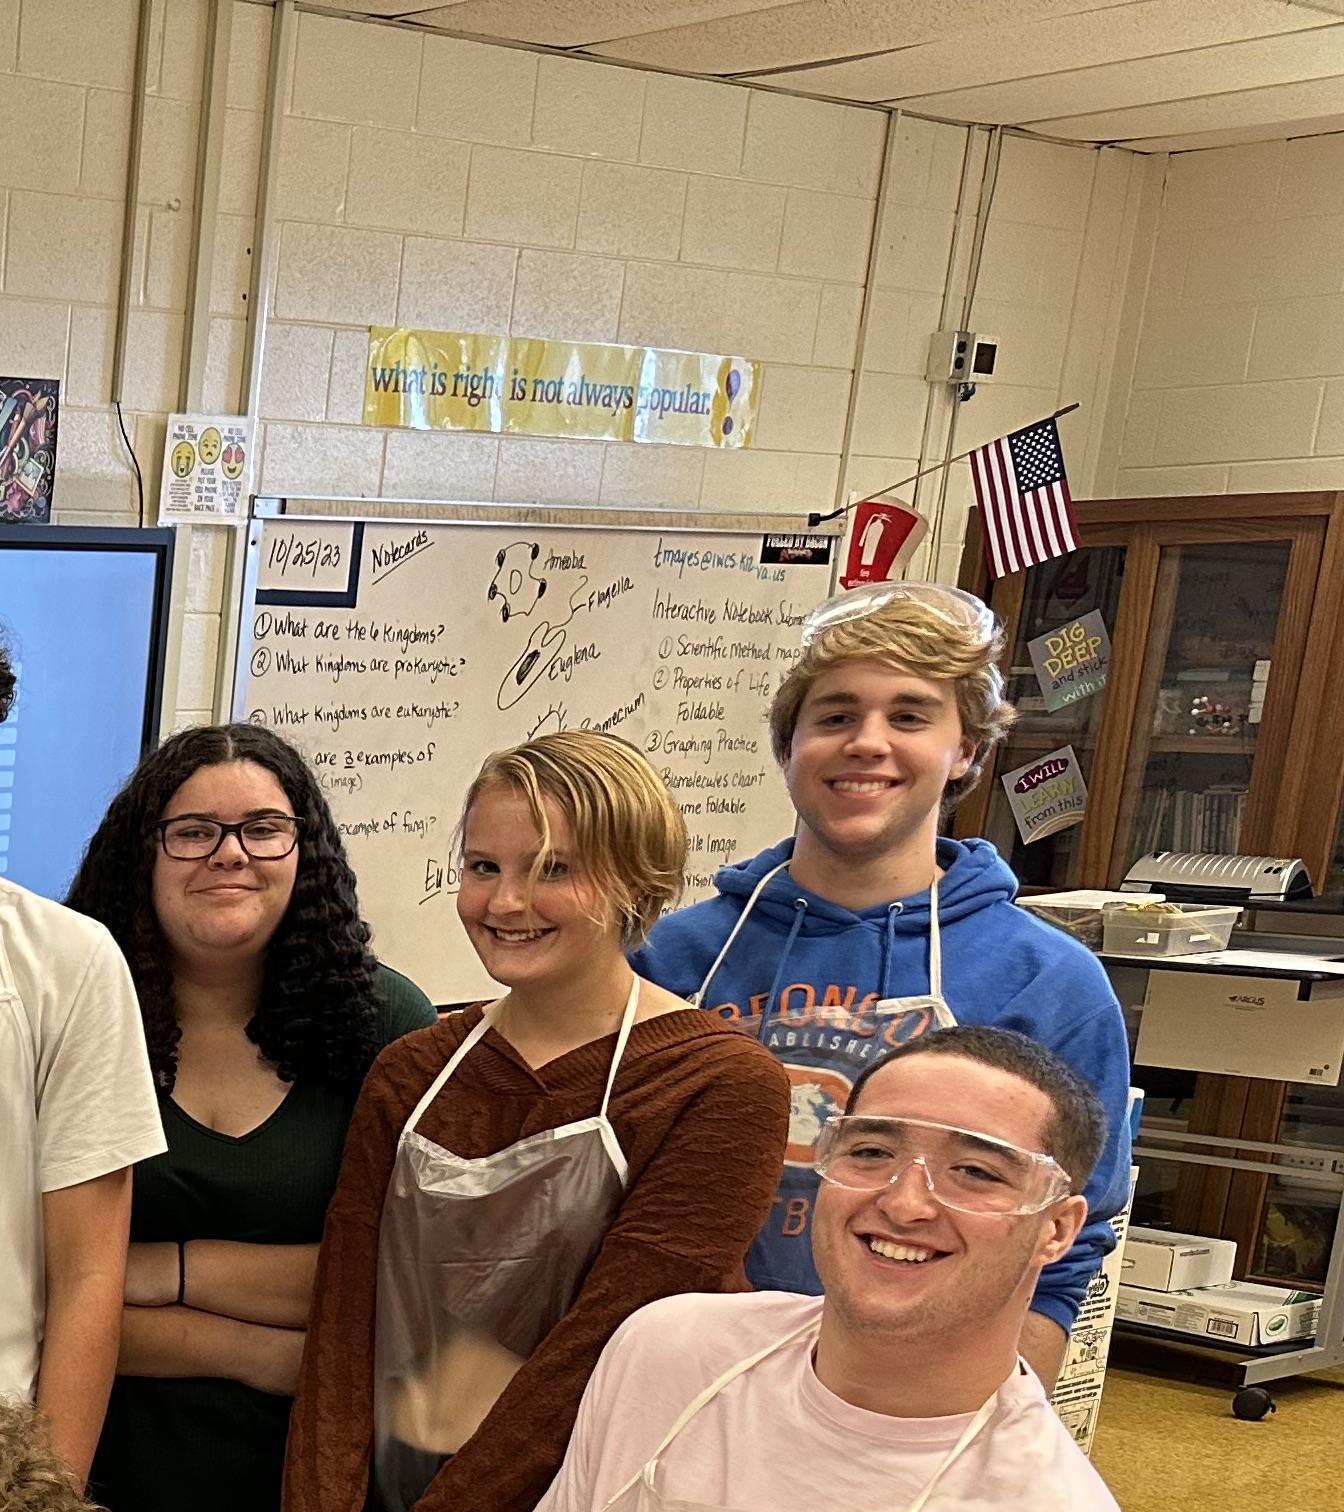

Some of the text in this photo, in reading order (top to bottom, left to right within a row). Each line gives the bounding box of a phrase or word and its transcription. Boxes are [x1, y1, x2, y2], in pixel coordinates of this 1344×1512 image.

[372, 361, 427, 394] what
[430, 367, 447, 396] is
[509, 368, 527, 401] is
[531, 372, 564, 403] not
[567, 377, 633, 417] always
[268, 533, 342, 578] 10/25/23
[372, 529, 429, 574] Notecards
[652, 588, 773, 626] Interactive Notebook
[274, 611, 309, 638] What
[314, 621, 341, 641] are
[346, 620, 367, 637] the
[1045, 622, 1086, 657] DIG
[276, 648, 310, 675] What
[370, 658, 390, 672] are
[677, 633, 728, 660] Scientific
[1043, 636, 1102, 679] DEEP
[548, 643, 601, 683] Euglena
[673, 666, 723, 697] Properties
[726, 669, 745, 694] of
[749, 671, 770, 697] Life
[1051, 667, 1075, 690] and
[1062, 681, 1095, 703] with
[273, 702, 310, 725] What
[371, 704, 391, 719] are
[676, 699, 726, 725] Foldable
[315, 752, 337, 766] are
[357, 749, 414, 772] examples
[416, 742, 436, 762] of
[663, 730, 713, 765] Graphing
[716, 728, 759, 754] Practice
[320, 772, 363, 795] (image)
[1018, 764, 1067, 791] I WILL
[337, 810, 437, 839] example of fungi?
[1024, 794, 1084, 830] from this
